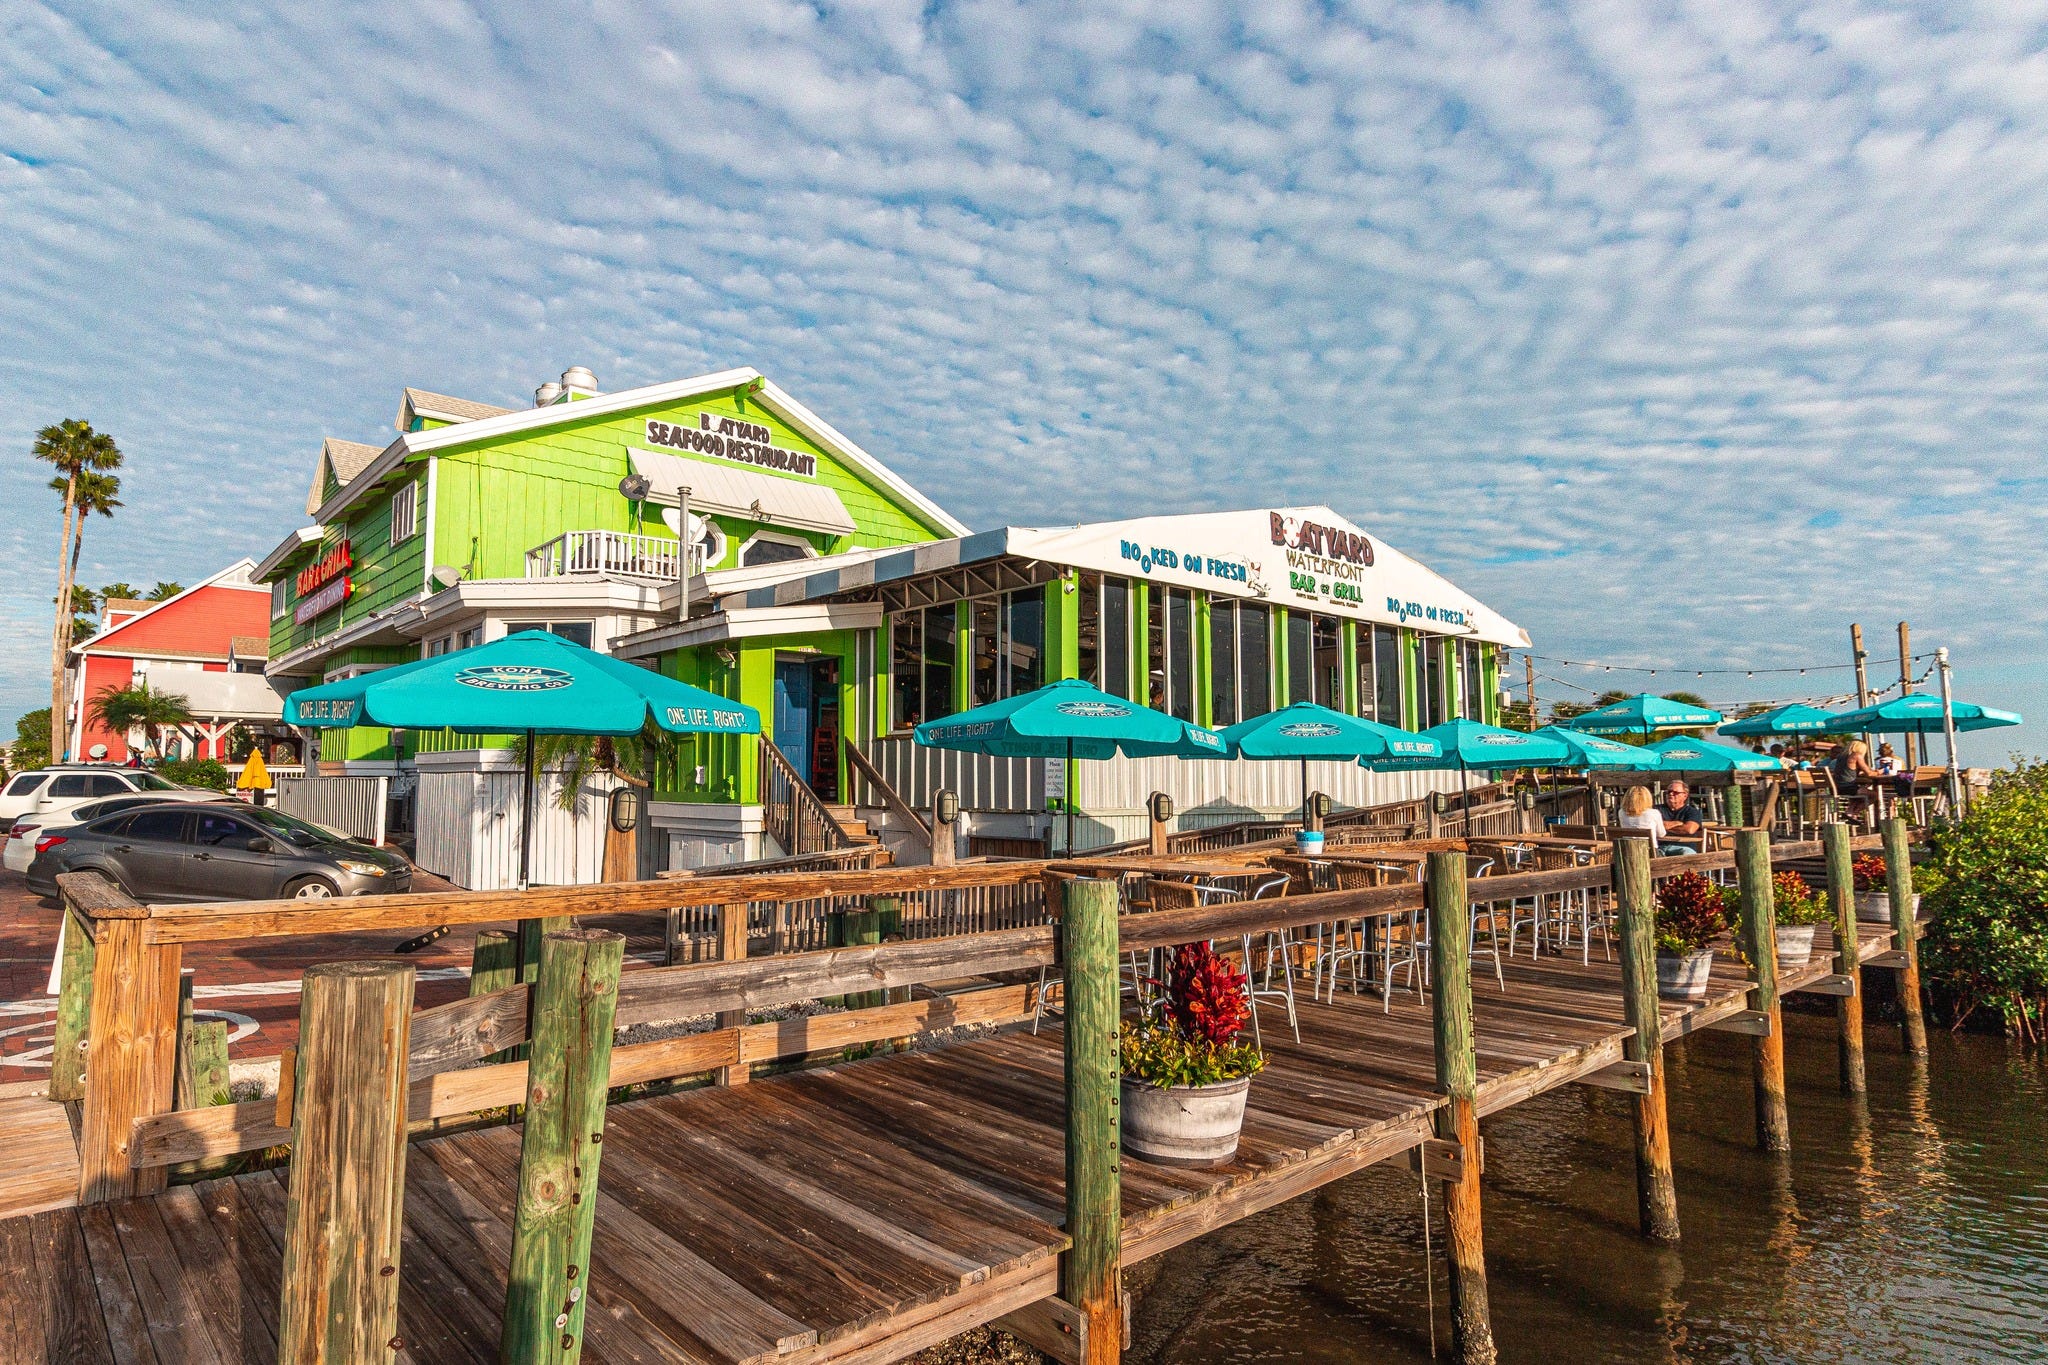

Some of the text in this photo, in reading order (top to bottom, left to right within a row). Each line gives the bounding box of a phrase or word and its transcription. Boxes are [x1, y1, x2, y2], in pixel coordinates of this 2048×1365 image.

[647, 421, 815, 476] SEAFOOD RESTAURANT
[1270, 511, 1375, 567] BOATYARD
[295, 563, 316, 599] BAR
[320, 540, 351, 582] GRILL
[1120, 539, 1246, 582] HOOKED ON FRESH
[1286, 549, 1364, 582] WATERFRONT
[1289, 571, 1316, 593] BAR
[1333, 582, 1363, 603] GRILL
[1387, 596, 1464, 625] HOOKED ON FRESH
[466, 677, 541, 690] BREWING
[492, 667, 543, 675] KONA
[300, 701, 313, 719] ONE
[331, 700, 355, 721] RIGHT?
[667, 707, 748, 728] ONE LIFE. RIGHT?
[929, 728, 944, 740] ONE
[966, 721, 994, 737] RIGHT?
[1394, 741, 1405, 752] ONE
